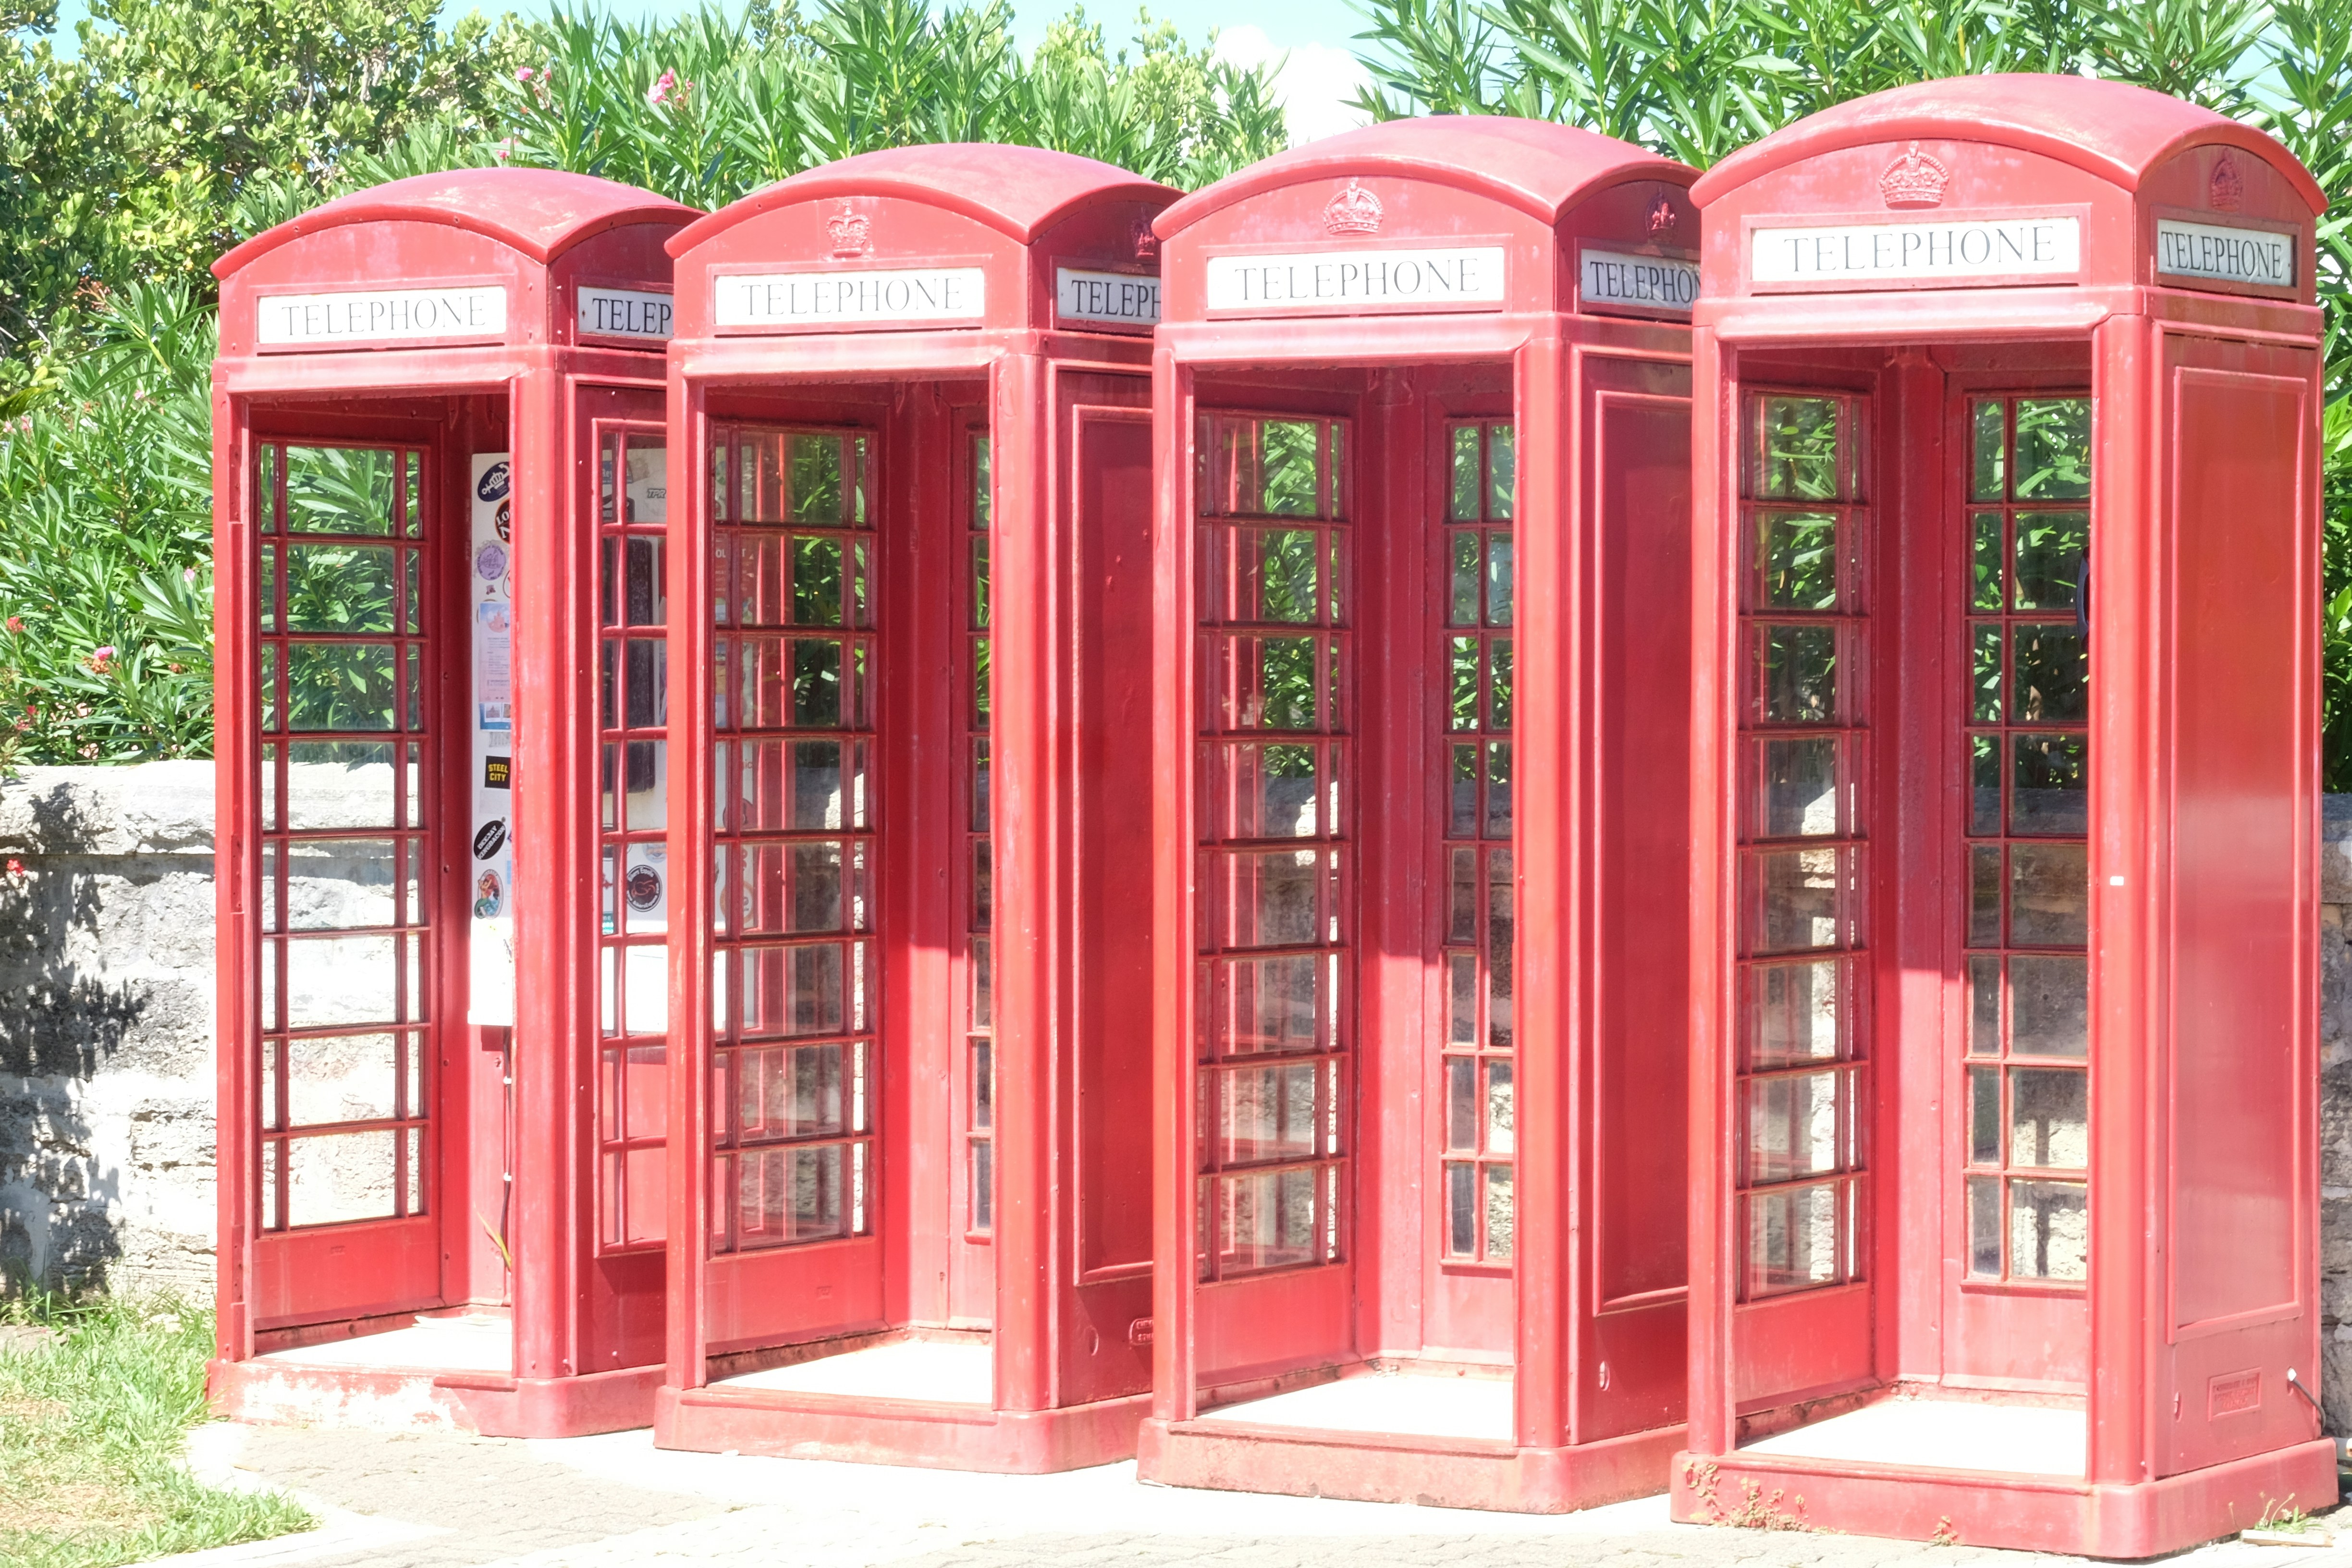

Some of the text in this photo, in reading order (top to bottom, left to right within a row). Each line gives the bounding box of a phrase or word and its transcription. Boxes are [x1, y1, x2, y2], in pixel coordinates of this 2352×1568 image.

[1784, 226, 2055, 272] TELEPHONE
[2161, 232, 2282, 279] TELEPHONE
[741, 277, 963, 316] TELEPHONE
[1234, 258, 1480, 301] TELEPHONE
[282, 295, 486, 336] TELEPHONE
[592, 298, 674, 335] TELEP
[488, 763, 509, 773] STEEL
[490, 772, 506, 782] CITY
